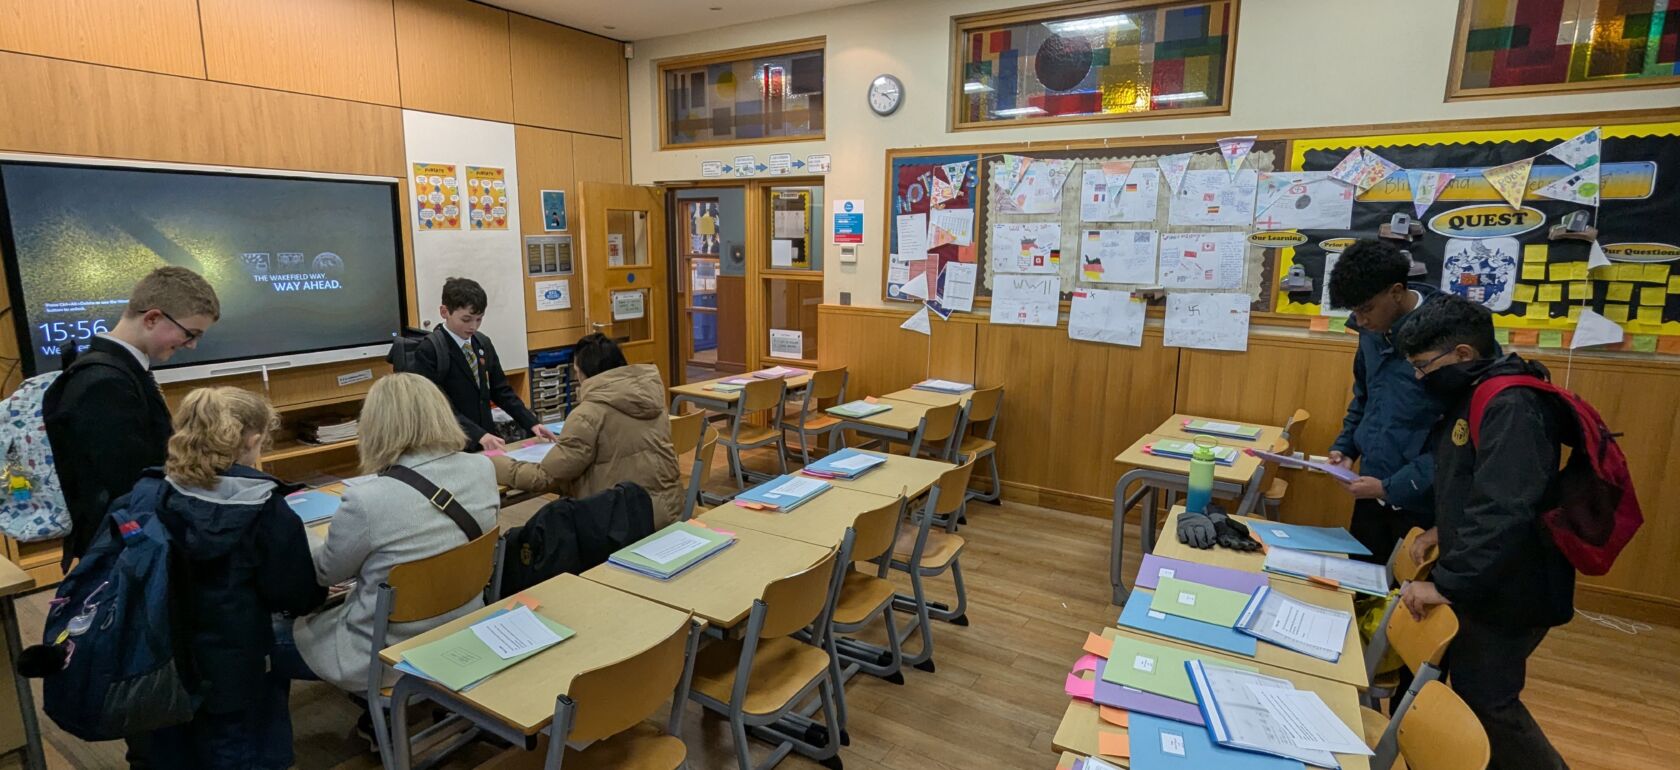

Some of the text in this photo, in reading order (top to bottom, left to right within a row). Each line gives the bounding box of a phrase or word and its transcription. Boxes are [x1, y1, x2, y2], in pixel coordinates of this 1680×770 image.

[1448, 212, 1528, 231] QUEST
[254, 274, 268, 282] THE
[270, 273, 308, 281] WAKEFIELD
[273, 280, 342, 291] WAY AHEAD.
[39, 319, 108, 342] 15:56
